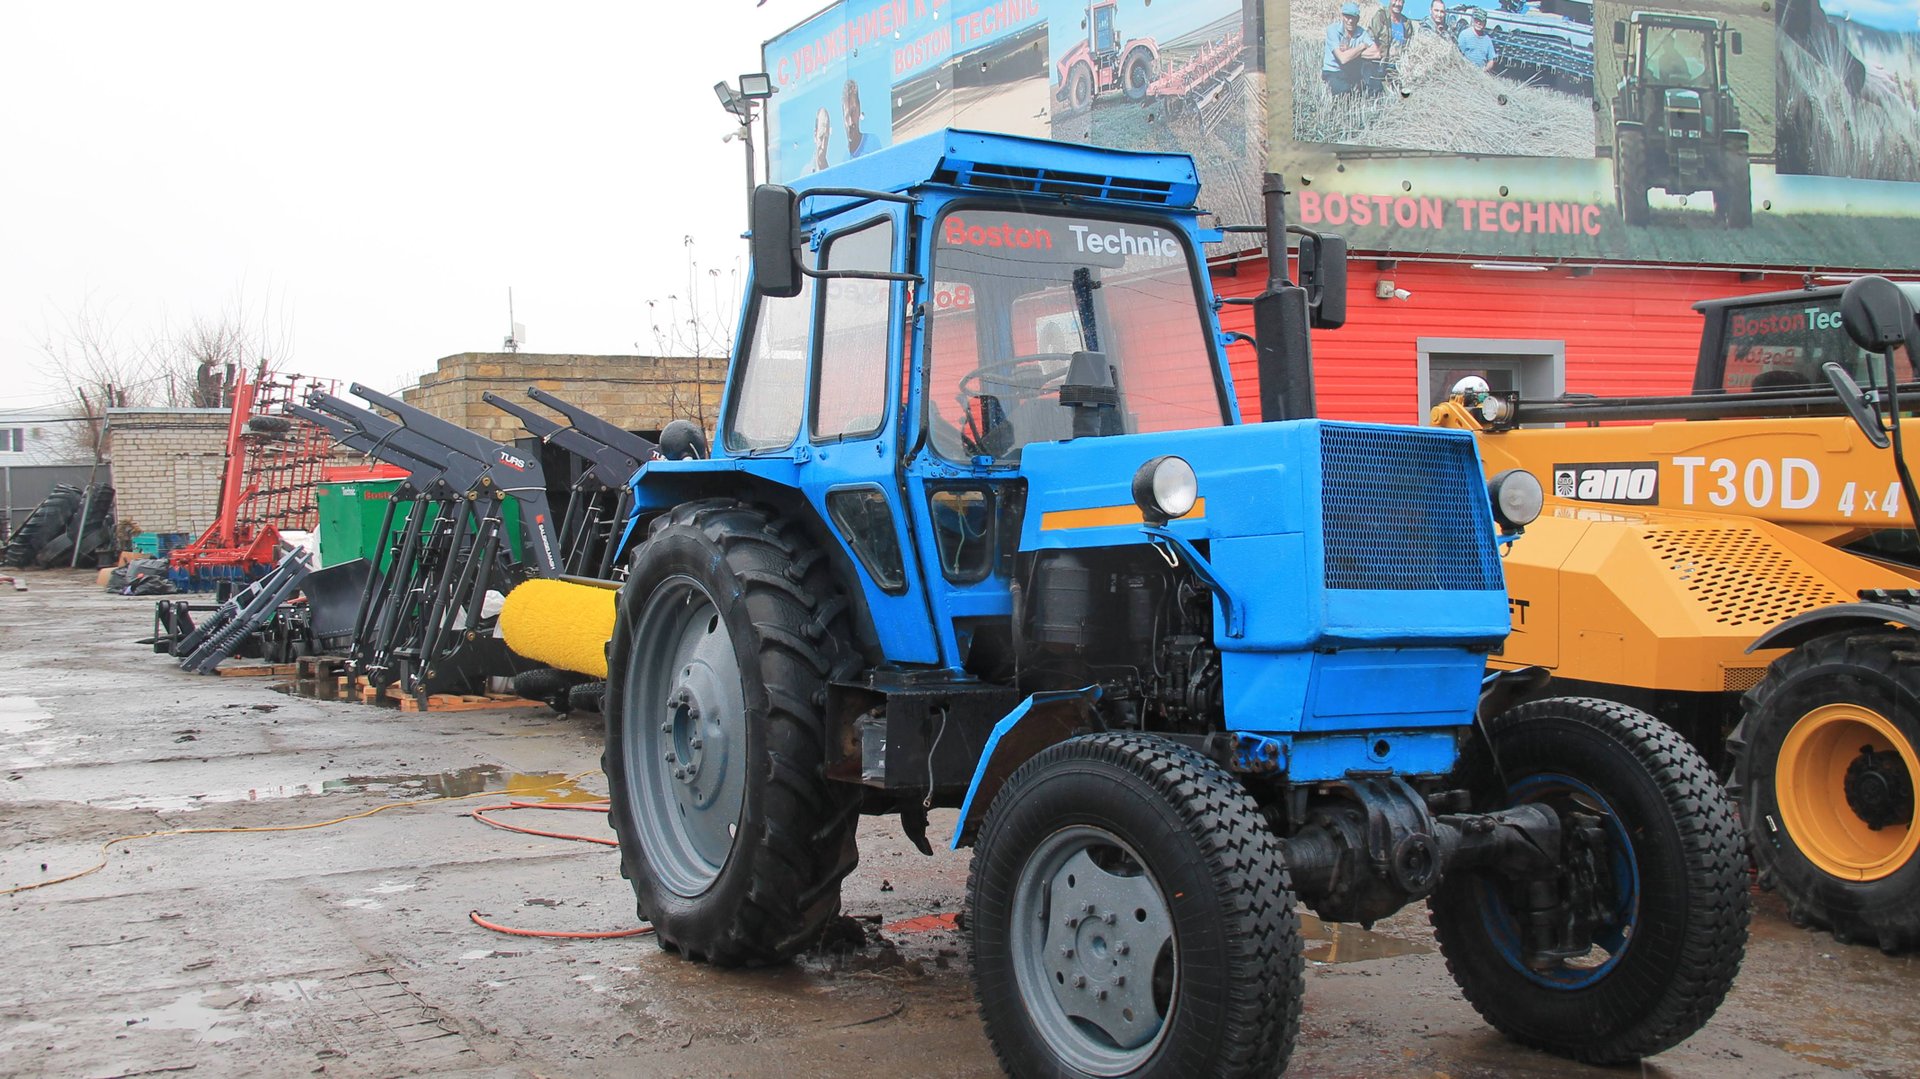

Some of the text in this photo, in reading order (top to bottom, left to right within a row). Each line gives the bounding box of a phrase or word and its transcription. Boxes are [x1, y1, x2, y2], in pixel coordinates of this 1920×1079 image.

[777, 57, 789, 85] С
[793, 0, 908, 80] УВАЖЕНИЕМ
[894, 0, 1039, 75] BOSTON TECHNIC
[1299, 191, 1601, 236] BOSTON TECHNIC
[944, 216, 1177, 258] Boston Technic
[1732, 313, 1805, 337] Boston
[500, 451, 526, 468] TURS
[1672, 456, 1820, 509] T30D
